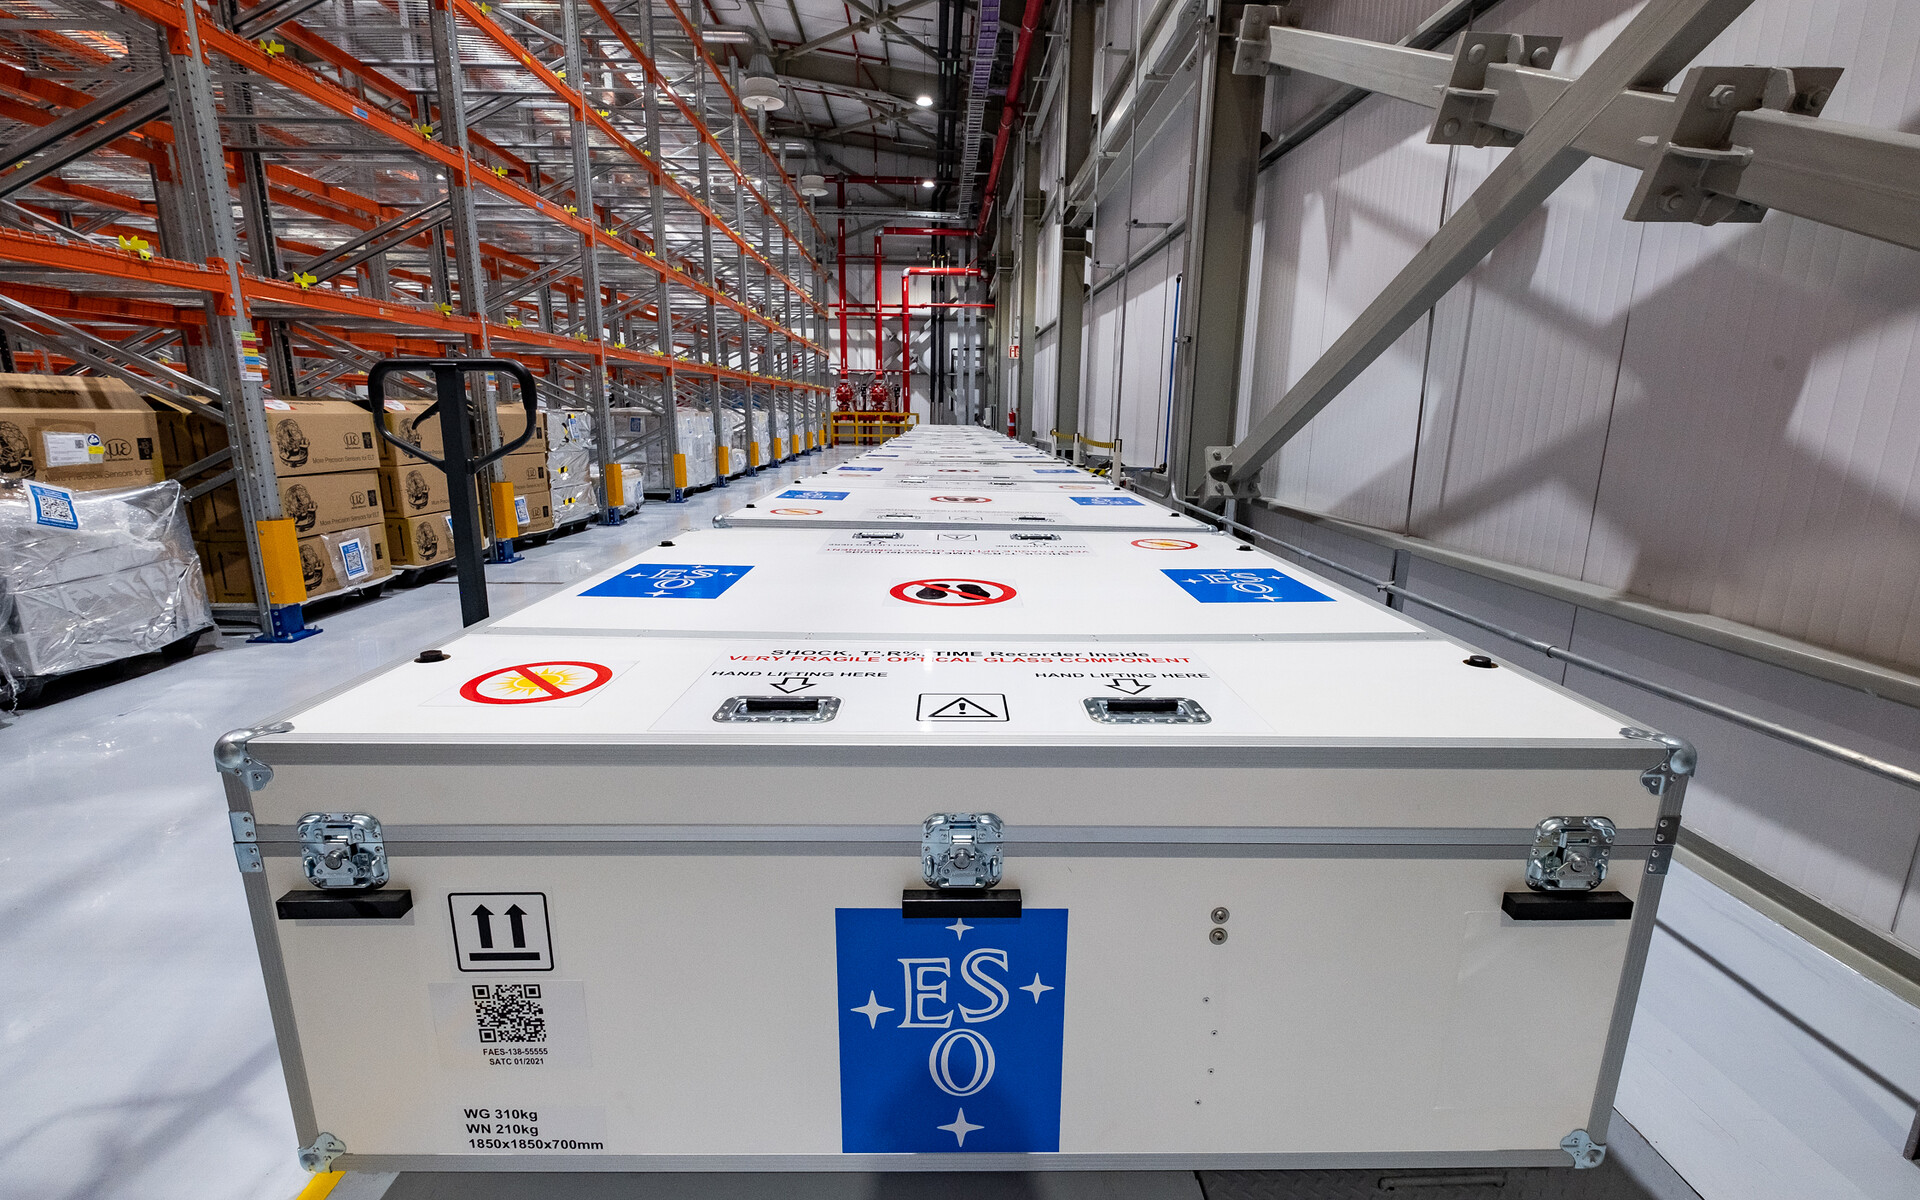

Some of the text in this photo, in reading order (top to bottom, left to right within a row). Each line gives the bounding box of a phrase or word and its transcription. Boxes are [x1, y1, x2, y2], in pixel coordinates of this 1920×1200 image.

[104, 469, 134, 478] Sensors
[482, 1048, 548, 1056] FAES-138-55555
[514, 1058, 544, 1066] 01/2021
[464, 1108, 538, 1122] WG 310kg
[466, 1124, 539, 1137] WN 210kg
[468, 1138, 604, 1150] 1850x1850x700mm
